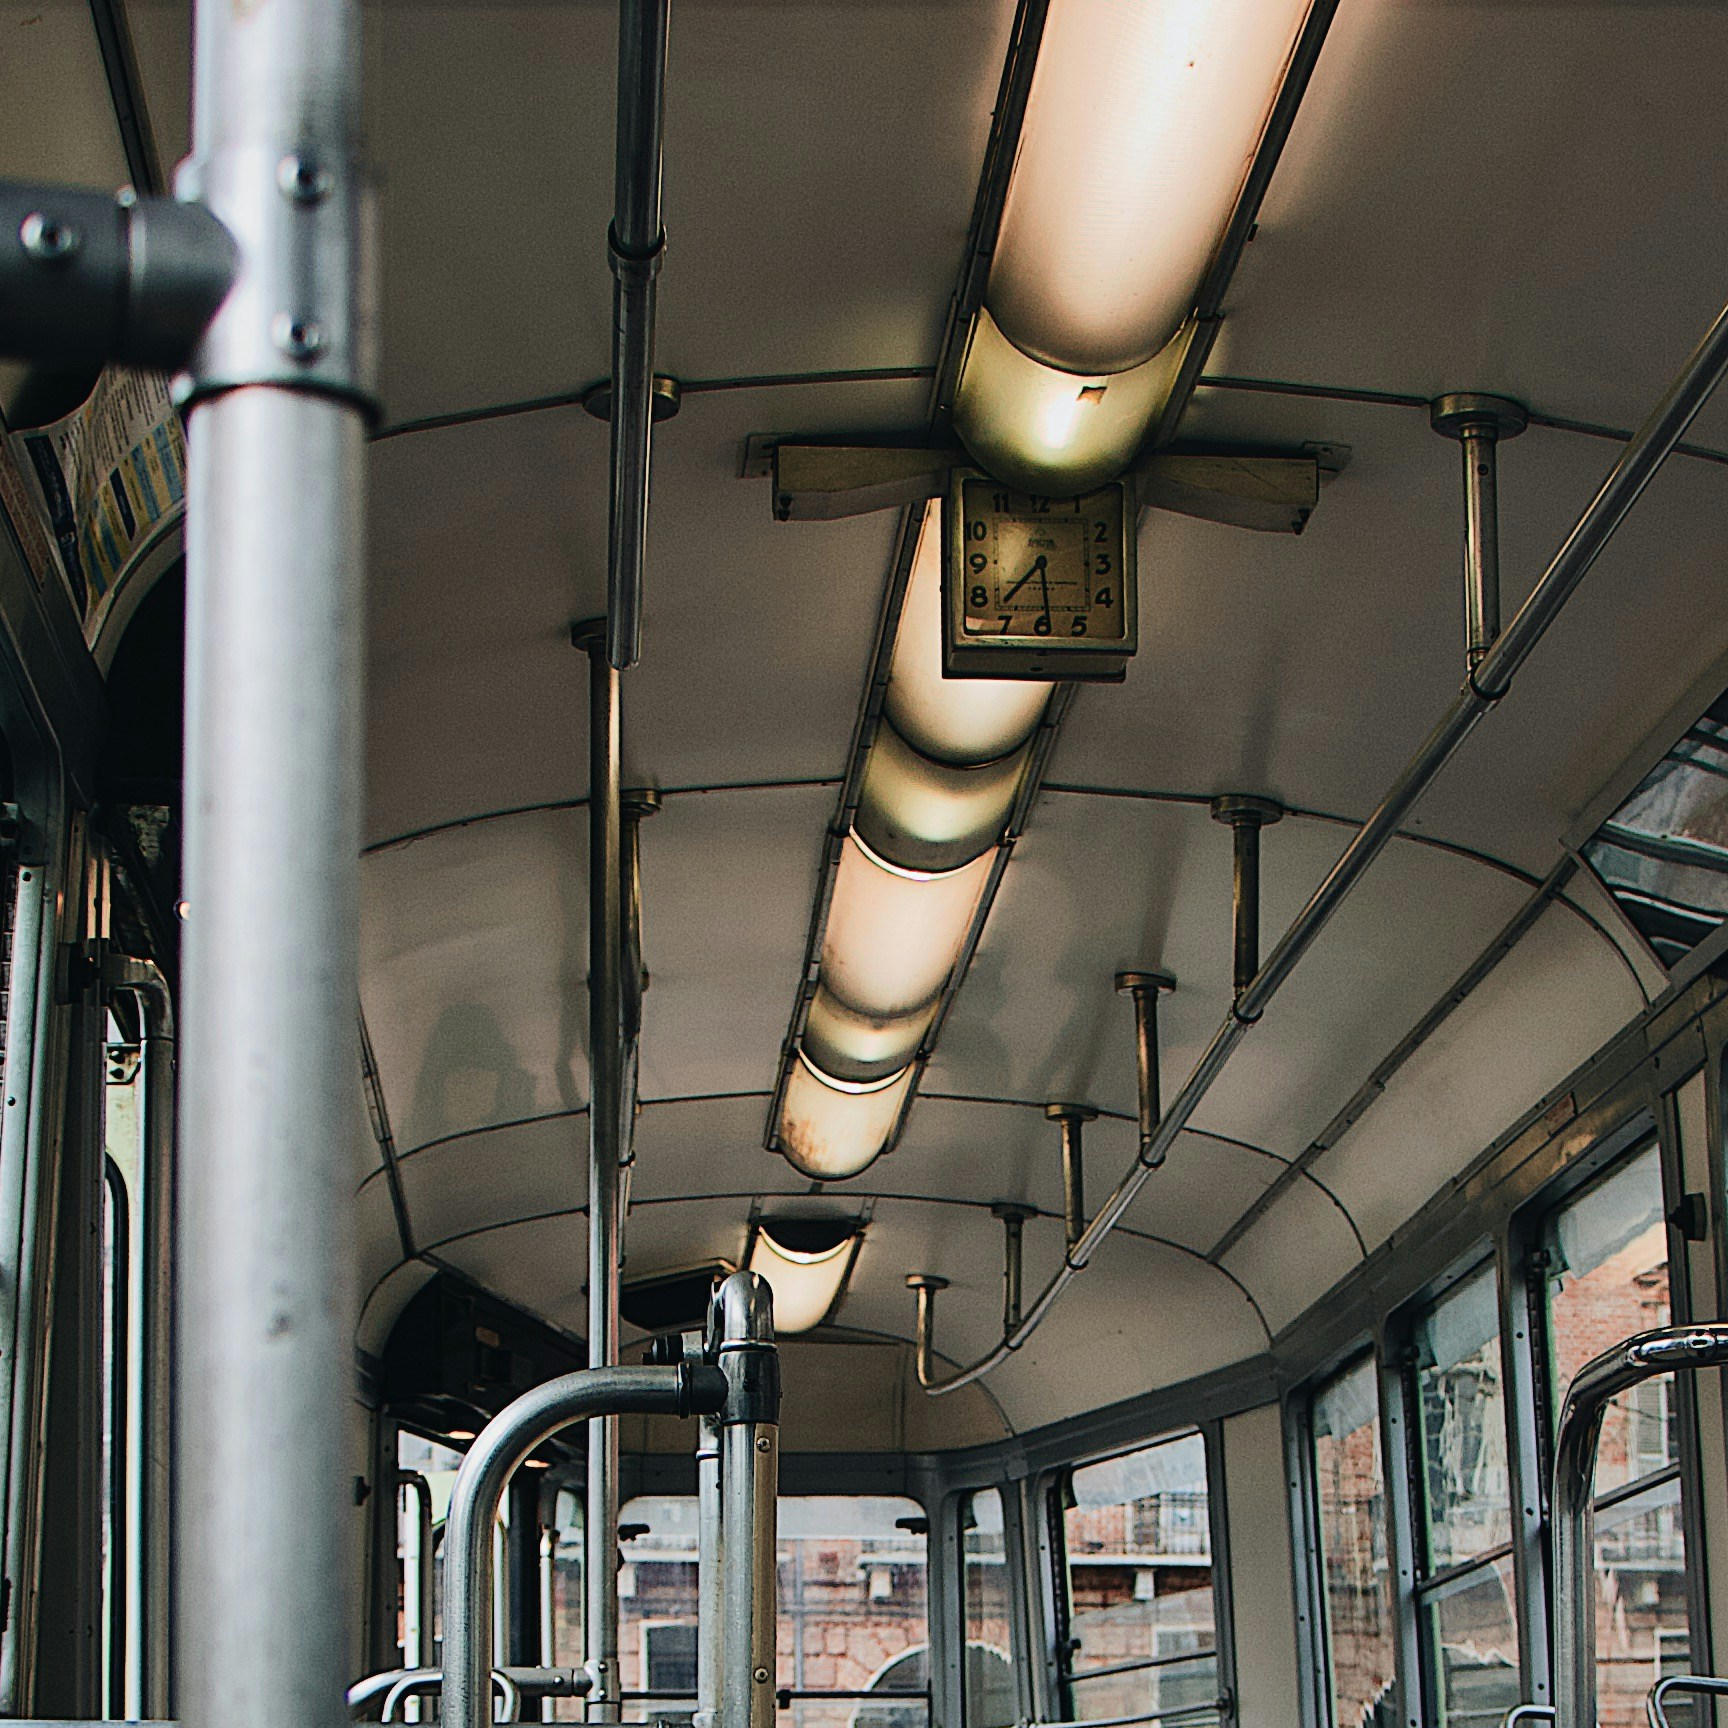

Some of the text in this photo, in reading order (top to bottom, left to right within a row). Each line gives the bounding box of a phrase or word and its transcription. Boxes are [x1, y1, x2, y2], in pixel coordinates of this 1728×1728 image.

[993, 493, 1010, 514] 11
[1029, 494, 1051, 514] 12
[1073, 494, 1082, 514] 1
[965, 520, 987, 542] 10
[1094, 522, 1108, 543] 2
[969, 553, 988, 575] 9
[1095, 553, 1112, 575] 3
[970, 585, 988, 608] 8
[1094, 586, 1114, 609] 4
[997, 615, 1013, 635] 7
[1034, 614, 1052, 637] 6
[1071, 615, 1088, 637] 5
